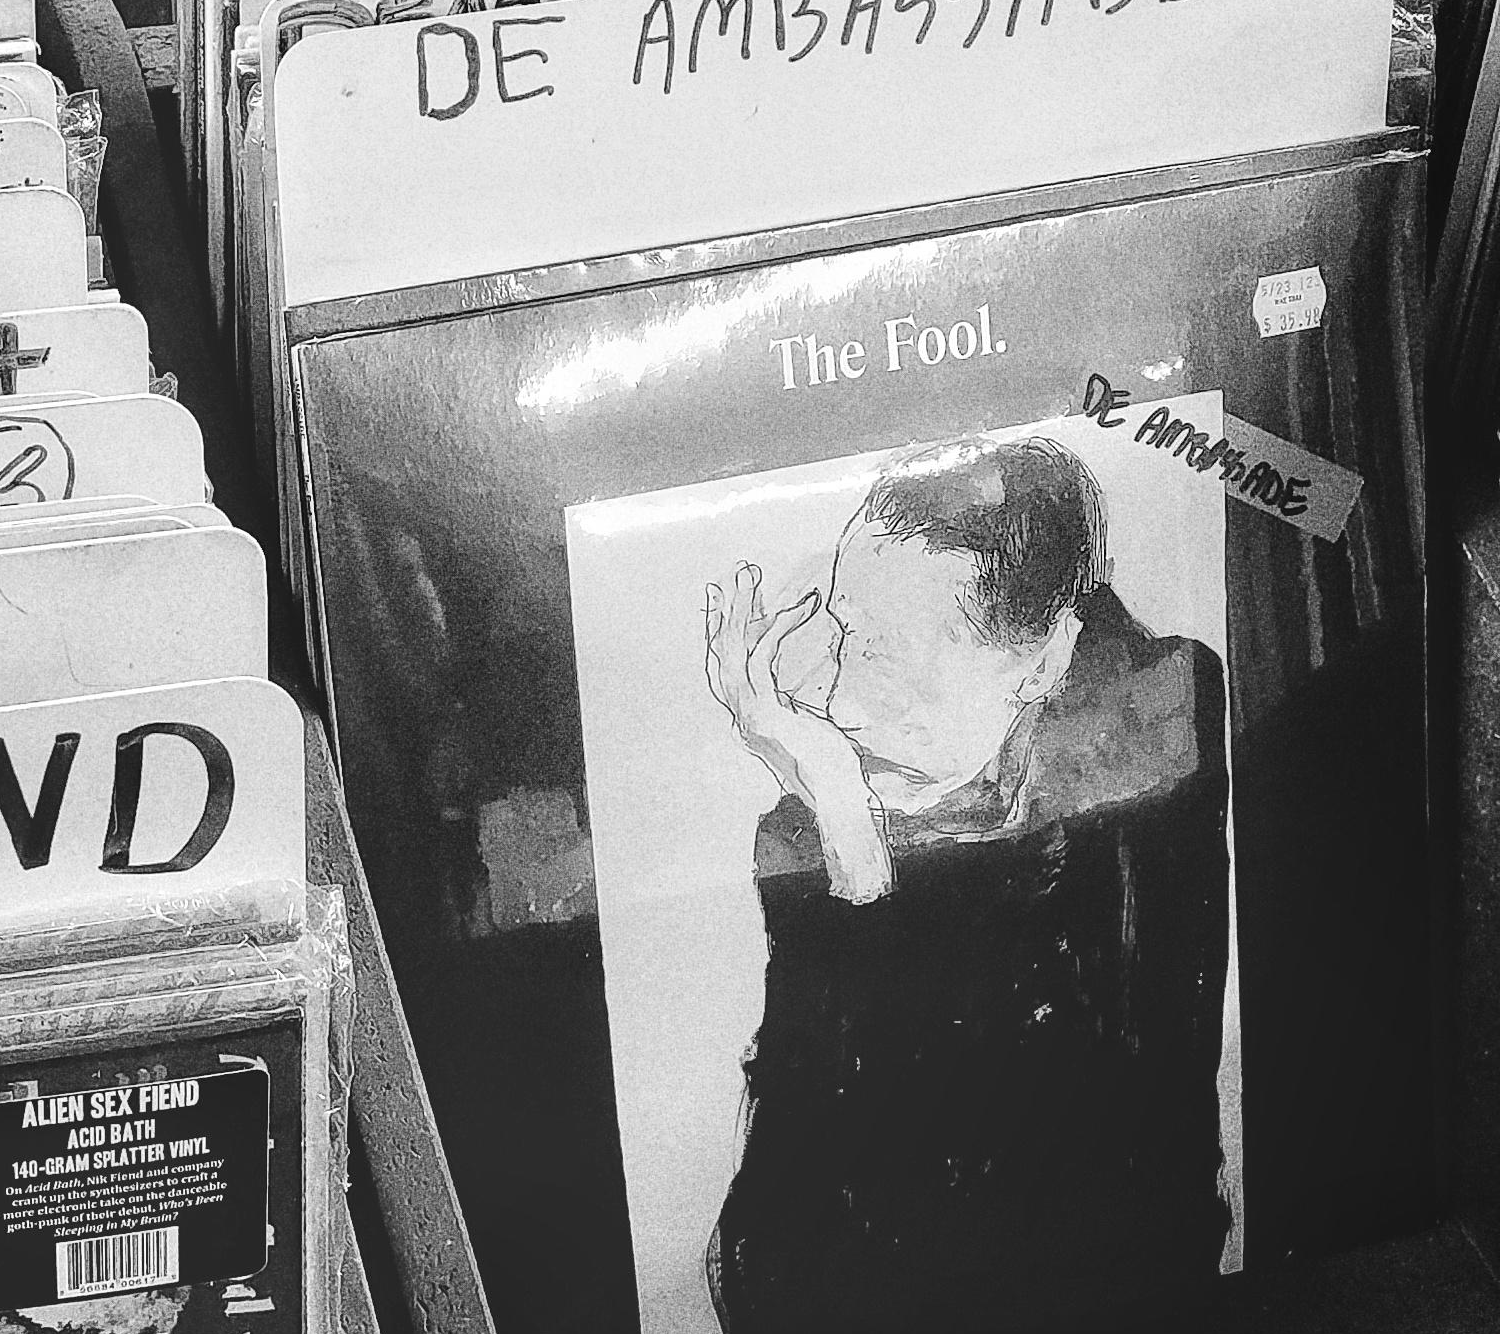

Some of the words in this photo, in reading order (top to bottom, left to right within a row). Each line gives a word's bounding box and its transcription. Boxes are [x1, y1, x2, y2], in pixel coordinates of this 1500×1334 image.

[416, 15, 566, 121] DE
[768, 329, 867, 392] The
[884, 303, 1008, 373] Fool.
[1082, 372, 1132, 428] DE
[21, 1094, 85, 1129] ALIEN
[90, 1088, 133, 1120] SEX
[138, 1079, 201, 1114] FIEND
[66, 1125, 106, 1150] ACID
[110, 1118, 157, 1145] BATH
[5, 1186, 23, 1196] On
[24, 1183, 50, 1194] Acid
[86, 1174, 108, 1186] Nik
[110, 1171, 144, 1183] Fiend
[146, 1166, 169, 1178] and
[171, 1159, 224, 1175] company
[11, 1153, 90, 1181] 140-GRAM
[93, 1143, 165, 1171] SPLATTER
[169, 1136, 211, 1161] VINYL
[3, 1208, 34, 1220] more
[37, 1201, 97, 1216] electronic
[99, 1196, 125, 1208] take
[128, 1195, 144, 1204] on
[147, 1190, 165, 1201] the
[167, 1181, 227, 1198] danceable
[12, 1195, 47, 1207] crank
[49, 1194, 65, 1204] up
[67, 1188, 87, 1199] the
[89, 1177, 164, 1198] synthesizers
[166, 1177, 178, 1186] to
[181, 1172, 209, 1184] craft
[7, 1215, 69, 1234] goth-punk
[72, 1213, 86, 1223] of
[86, 1208, 117, 1221] their
[158, 1196, 193, 1210] Who's
[195, 1193, 223, 1206] Been
[54, 1222, 104, 1237] Sleeping
[106, 1219, 118, 1230] in
[120, 1216, 137, 1229] My
[140, 1211, 178, 1226] Brain?
